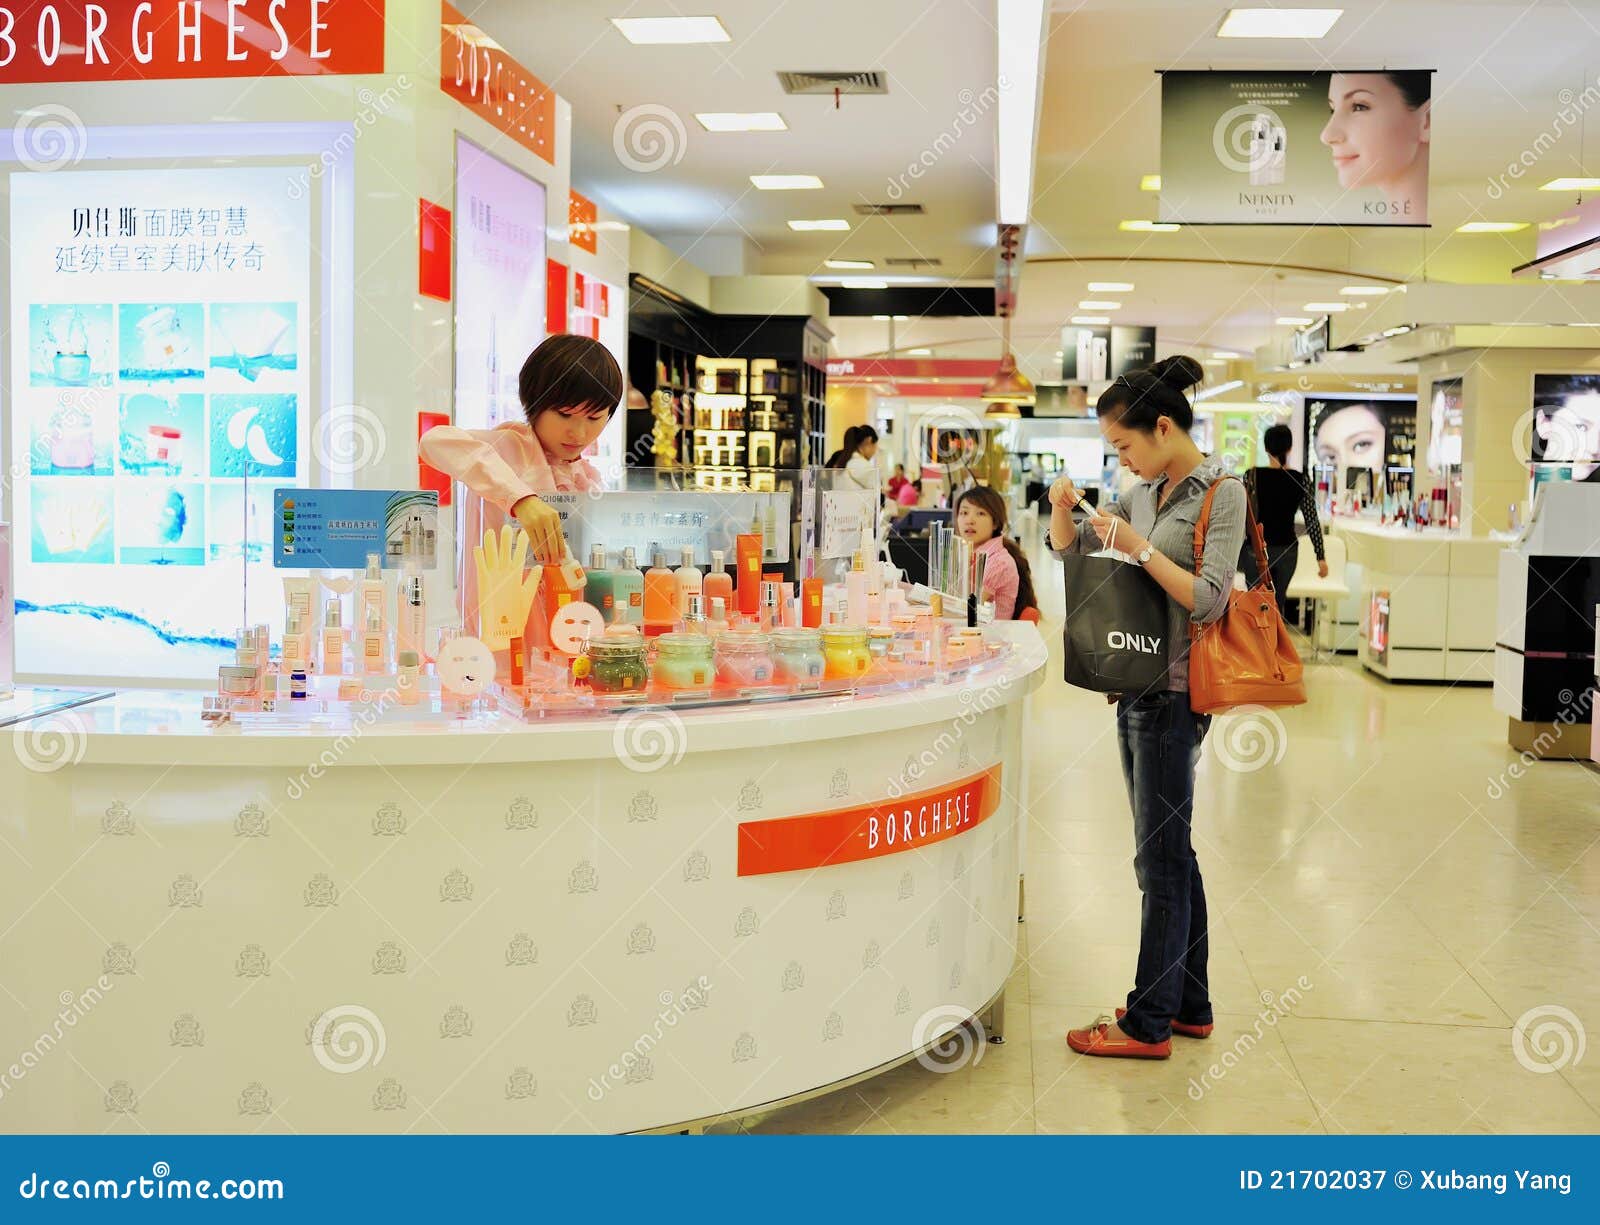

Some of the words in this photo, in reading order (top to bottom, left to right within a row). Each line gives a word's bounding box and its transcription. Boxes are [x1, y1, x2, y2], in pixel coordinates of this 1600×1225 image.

[0, 0, 332, 66] BORGHESE
[1238, 192, 1296, 206] INFINITY
[1363, 199, 1412, 215] KOSÉ
[55, 241, 266, 274] 延续皇室美肤传奇
[1107, 630, 1161, 655] ONLY
[868, 791, 970, 849] BORGHESE
